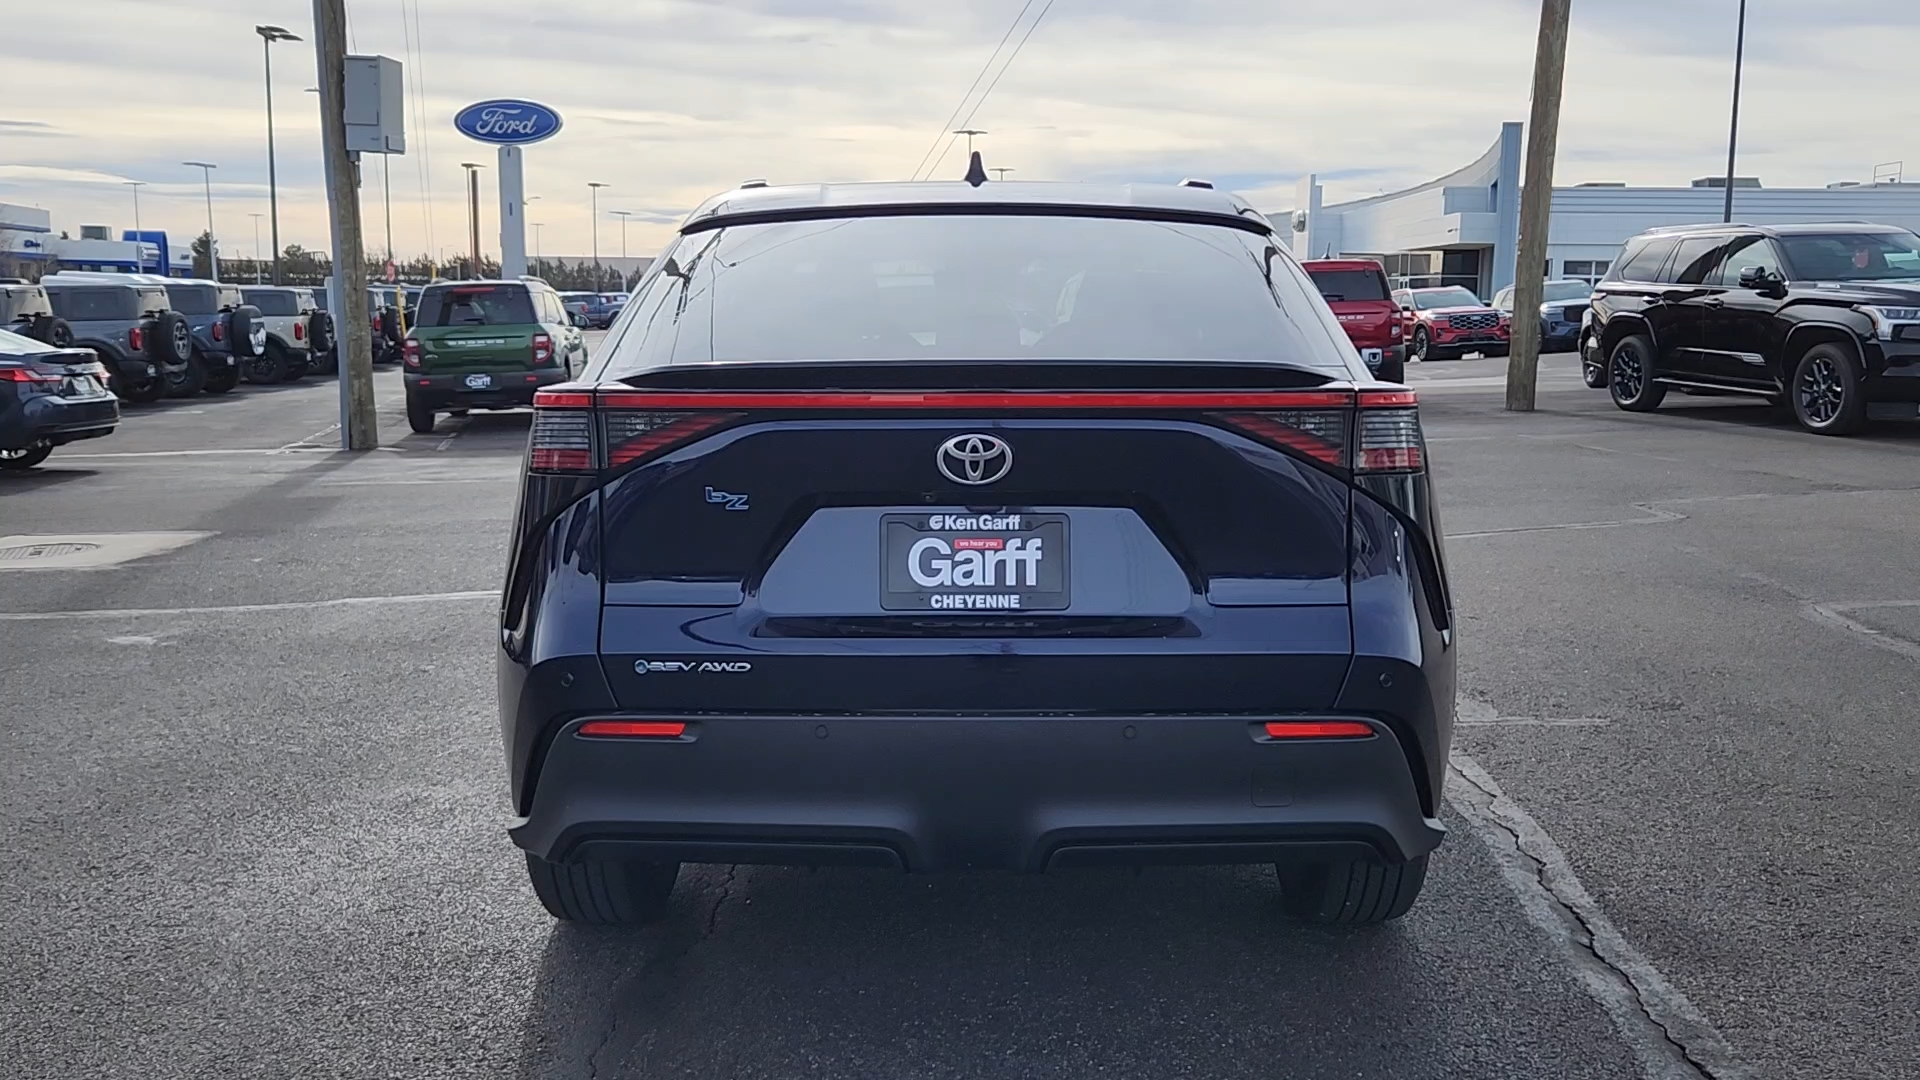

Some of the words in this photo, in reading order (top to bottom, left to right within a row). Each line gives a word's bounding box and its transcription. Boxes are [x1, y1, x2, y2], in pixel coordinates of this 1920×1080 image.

[475, 107, 538, 134] Ford
[944, 515, 977, 531] Ken
[979, 515, 1021, 530] Garff
[908, 537, 1043, 588] Garff
[930, 594, 1021, 609] CHEYENNE
[649, 661, 697, 672] BEV
[698, 661, 752, 672] AWD
